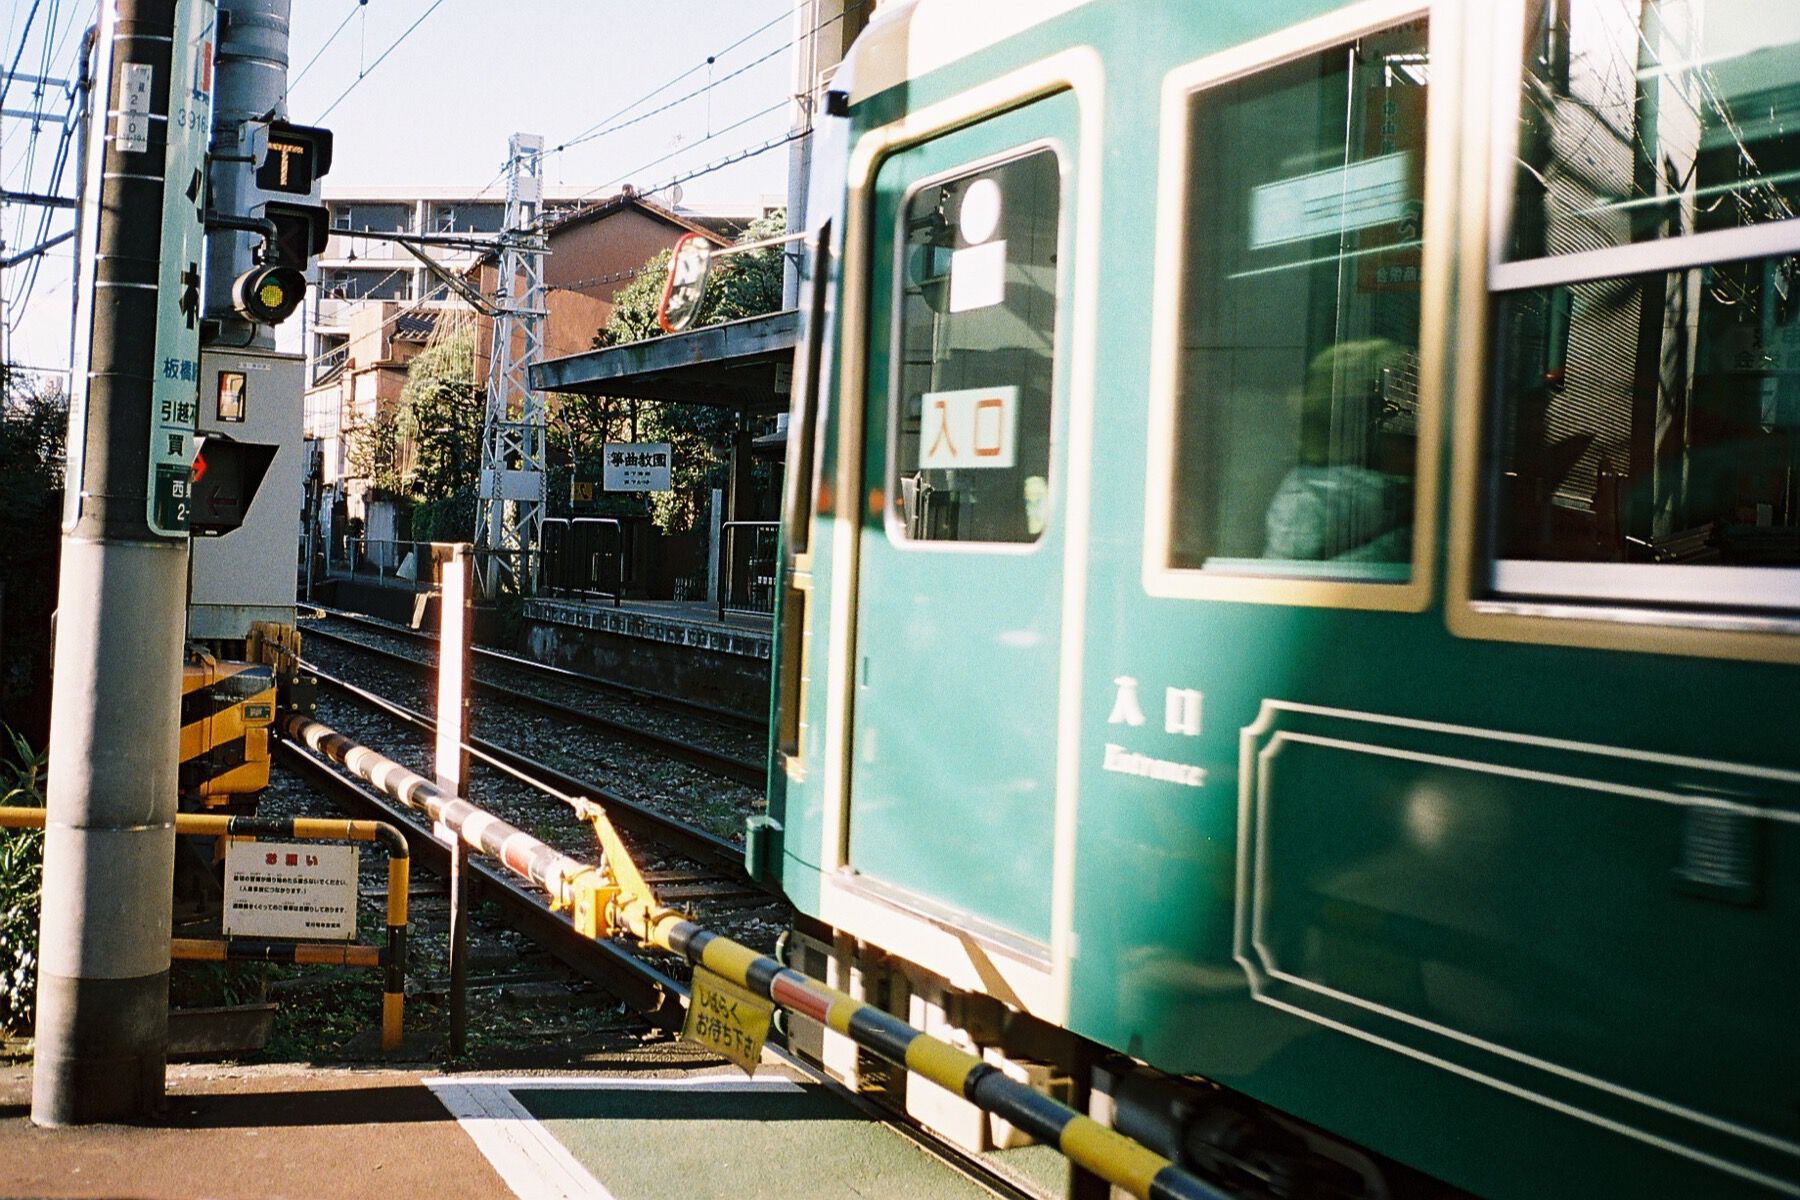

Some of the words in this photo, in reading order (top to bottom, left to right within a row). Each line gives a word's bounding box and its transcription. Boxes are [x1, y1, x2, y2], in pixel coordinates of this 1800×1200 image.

[168, 434, 184, 456] 買
[928, 398, 1003, 458] 入口
[1107, 676, 1205, 736] 入口
[265, 852, 319, 867] お願い
